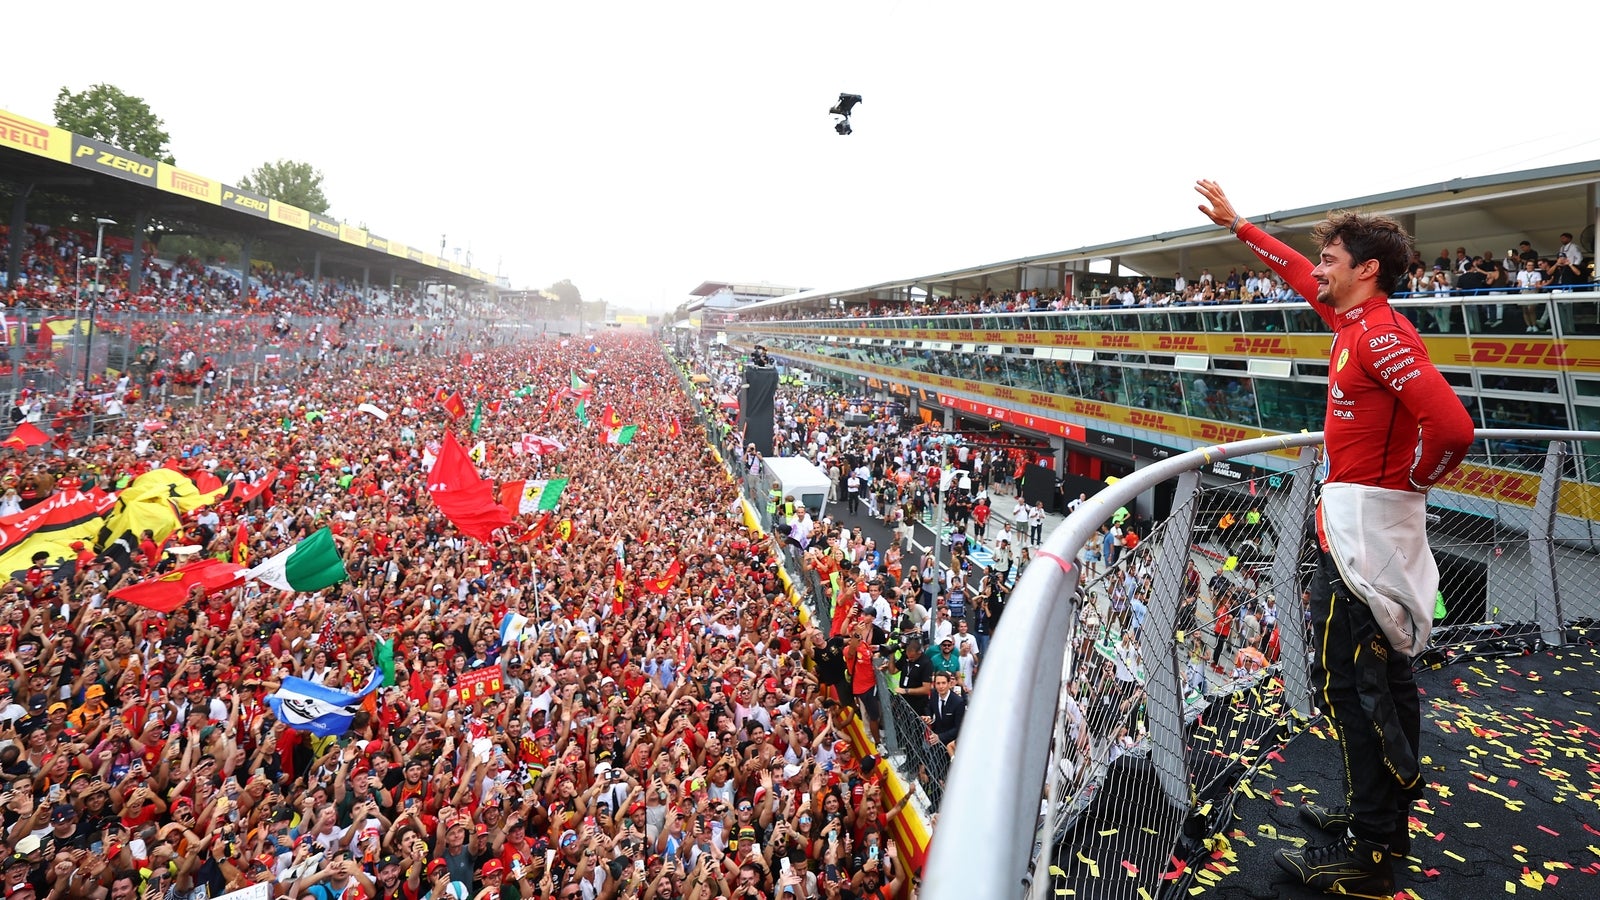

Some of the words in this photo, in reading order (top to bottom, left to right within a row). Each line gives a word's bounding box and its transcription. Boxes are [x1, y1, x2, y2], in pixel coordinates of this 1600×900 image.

[76, 145, 95, 157] P
[96, 152, 154, 178] ZERO
[172, 171, 209, 197] PIRELLI
[223, 191, 234, 200] P
[234, 194, 268, 212] ZERO
[1269, 254, 1288, 267] MILLE
[985, 332, 1003, 342] DHL
[1016, 333, 1037, 344] DHL
[1054, 334, 1081, 345] DHL
[1101, 335, 1133, 347] DHL
[1157, 336, 1199, 350] DHL
[1369, 333, 1398, 348] aws
[1232, 337, 1288, 354] DHL
[1373, 347, 1411, 369] Bitdefender
[1471, 342, 1577, 367] DHL
[1386, 356, 1415, 375] Palantir
[1398, 369, 1421, 385] CELSIUS
[994, 387, 1014, 399] DHL
[1030, 394, 1056, 407] DHL
[1074, 401, 1105, 417] DHL
[1129, 411, 1168, 430] DHL
[1200, 423, 1246, 443] DHL
[1212, 467, 1242, 479] HAMILTON
[1213, 461, 1231, 470] LEWIS
